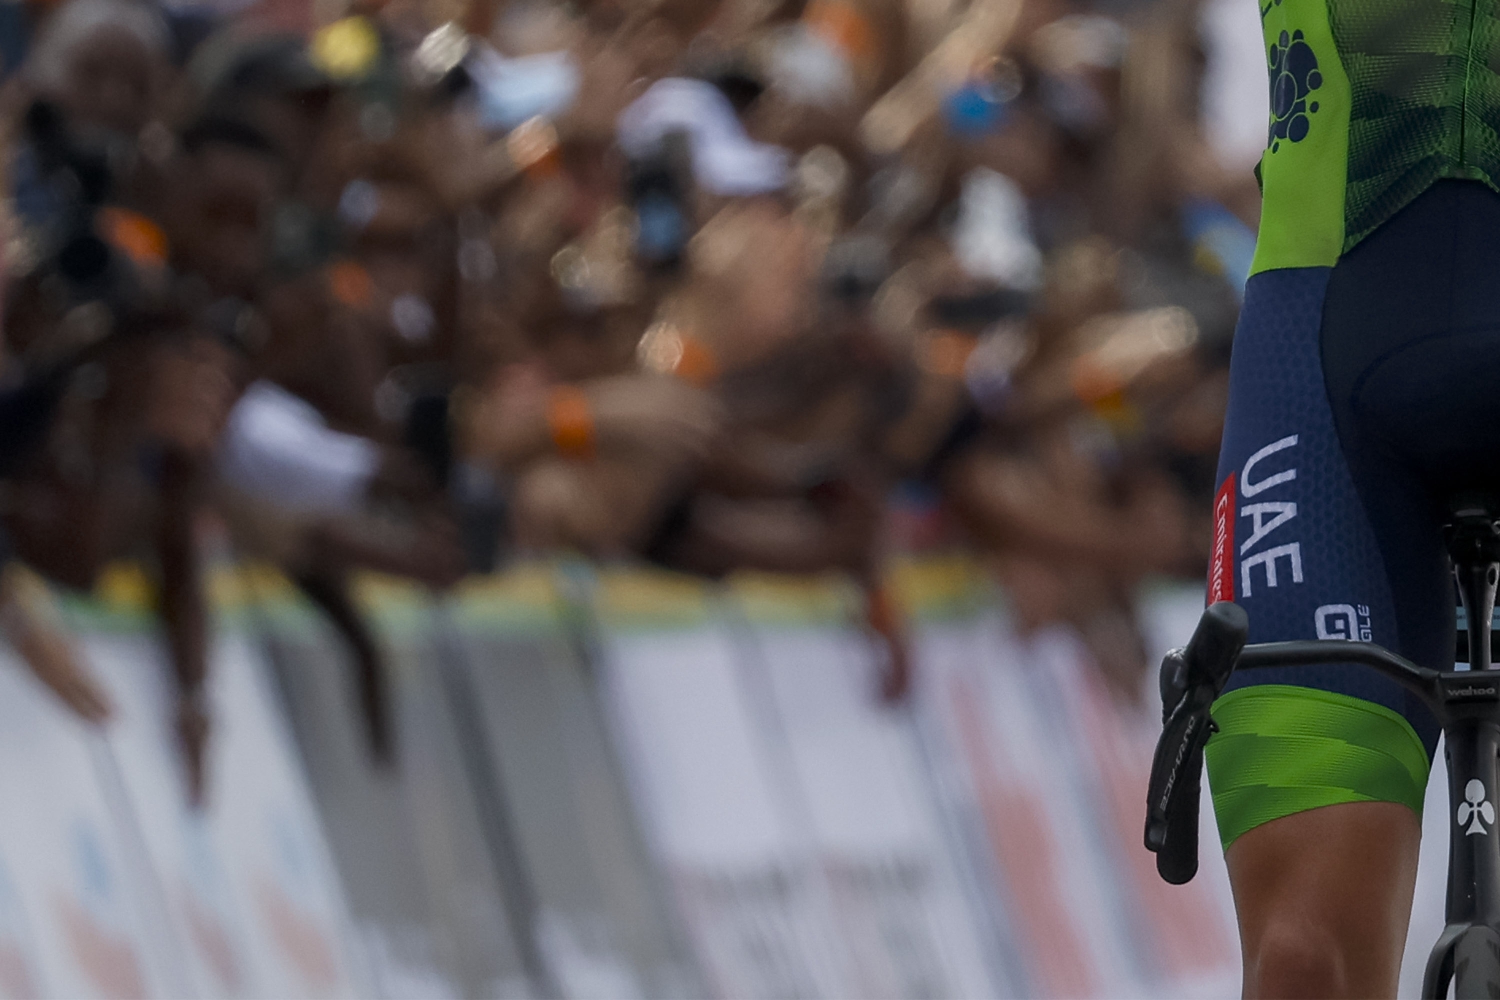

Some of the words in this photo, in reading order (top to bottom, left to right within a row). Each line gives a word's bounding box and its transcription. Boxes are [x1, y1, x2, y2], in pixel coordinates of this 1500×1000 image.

[1211, 492, 1228, 602] Emirates
[1240, 433, 1304, 598] UAE
[1447, 685, 1496, 697] wahoo
